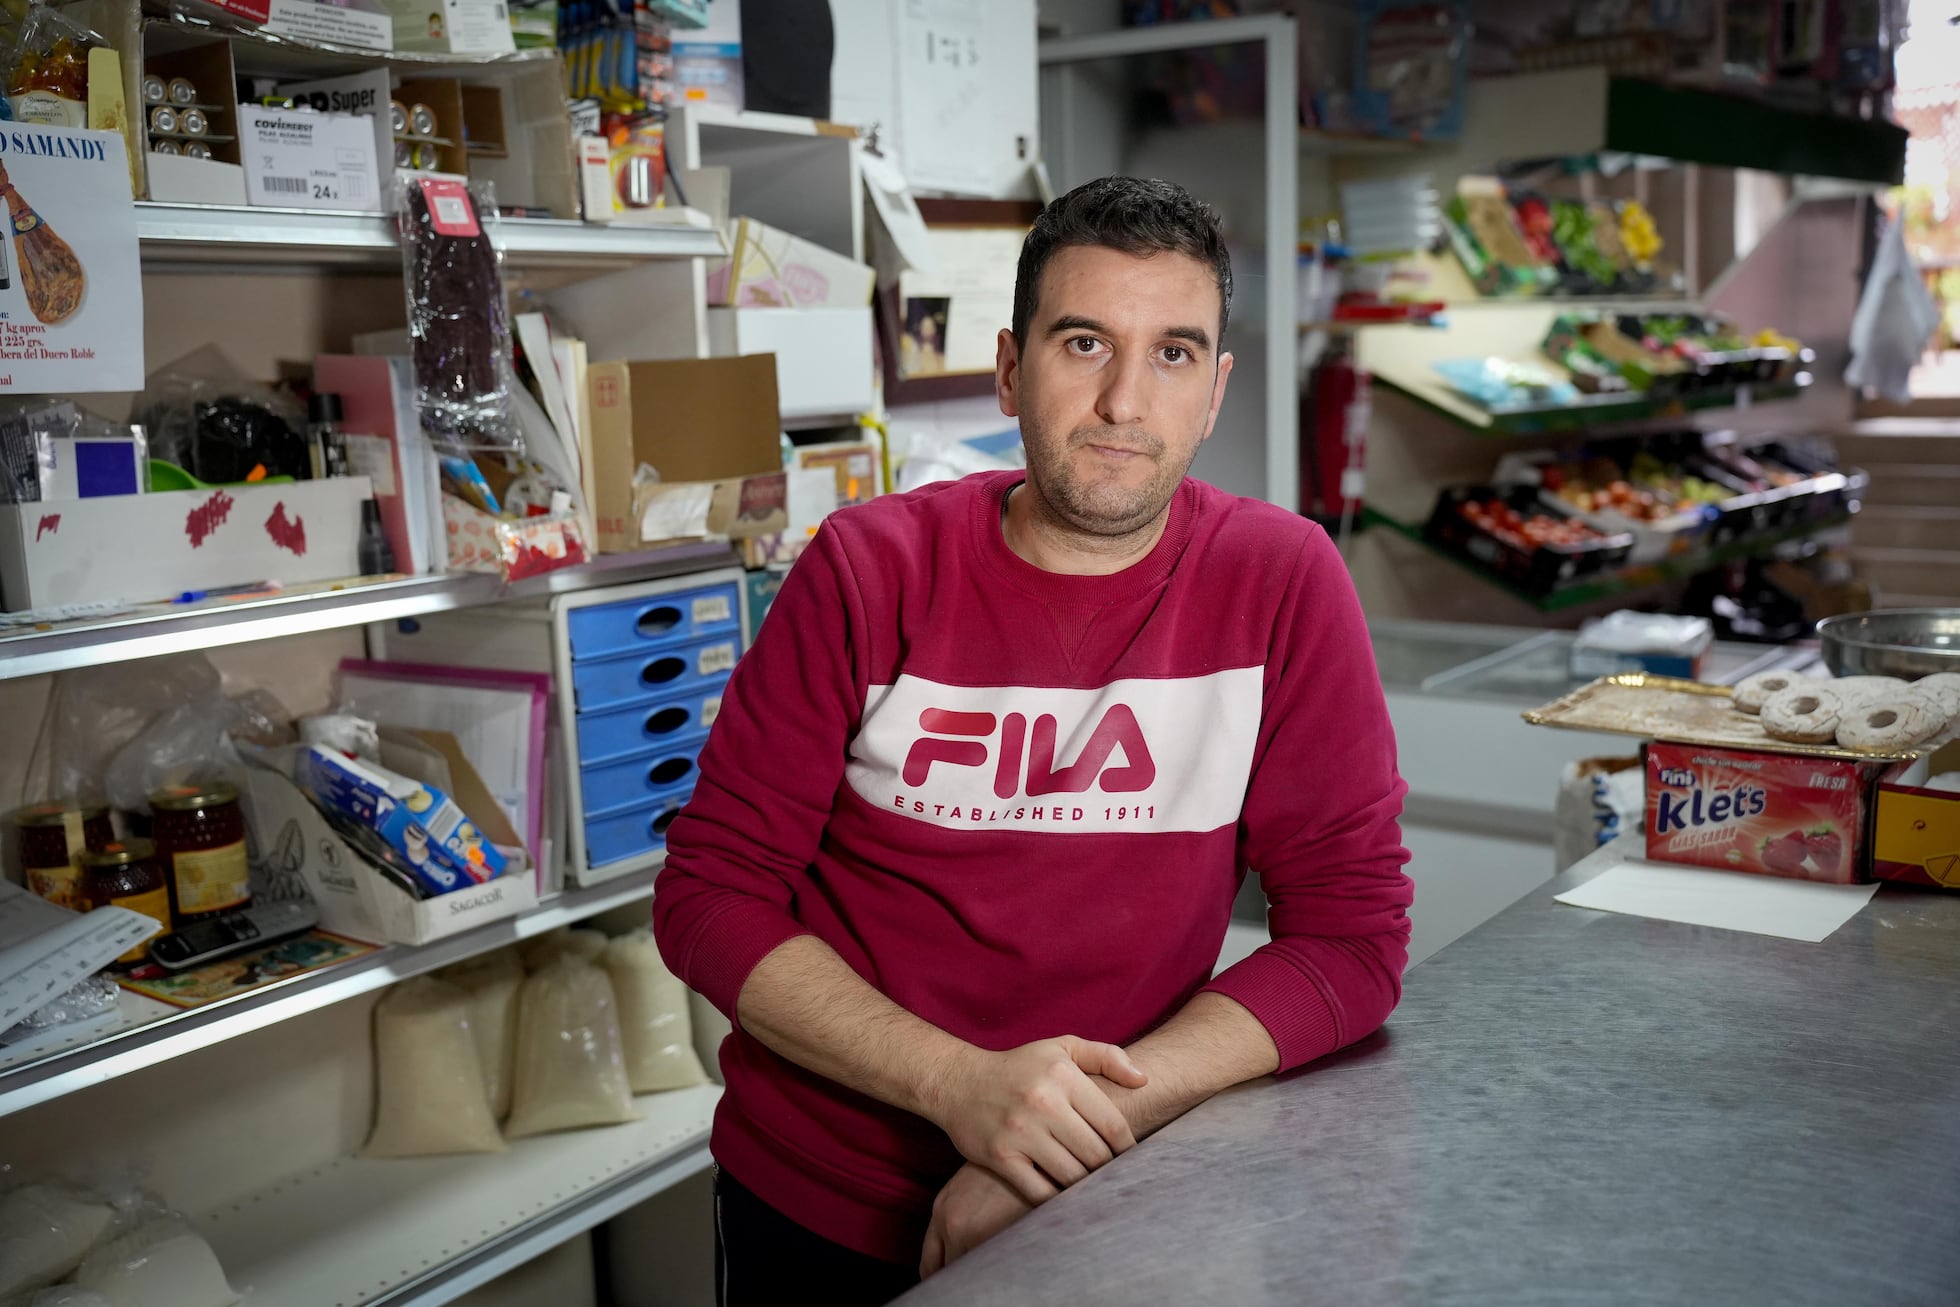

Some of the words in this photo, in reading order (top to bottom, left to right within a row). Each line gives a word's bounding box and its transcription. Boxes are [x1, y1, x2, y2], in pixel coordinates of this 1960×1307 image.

[331, 89, 376, 114] Super
[12, 132, 106, 161] SAMANDY
[313, 184, 330, 199] 24
[7, 322, 18, 334] kg
[20, 325, 46, 336] aprox
[5, 336, 25, 347] 225
[28, 339, 44, 347] grs.
[24, 349, 38, 359] del
[40, 348, 69, 359] Duero
[71, 347, 95, 359] Roble
[902, 703, 1156, 799] FILA
[1661, 768, 1694, 786] Fini
[1809, 772, 1848, 791] FRESA
[894, 795, 1084, 821] ESTABLISHED
[1104, 805, 1156, 821] 1911
[1699, 826, 1738, 847] SABOR
[449, 888, 504, 915] SAGACOR
